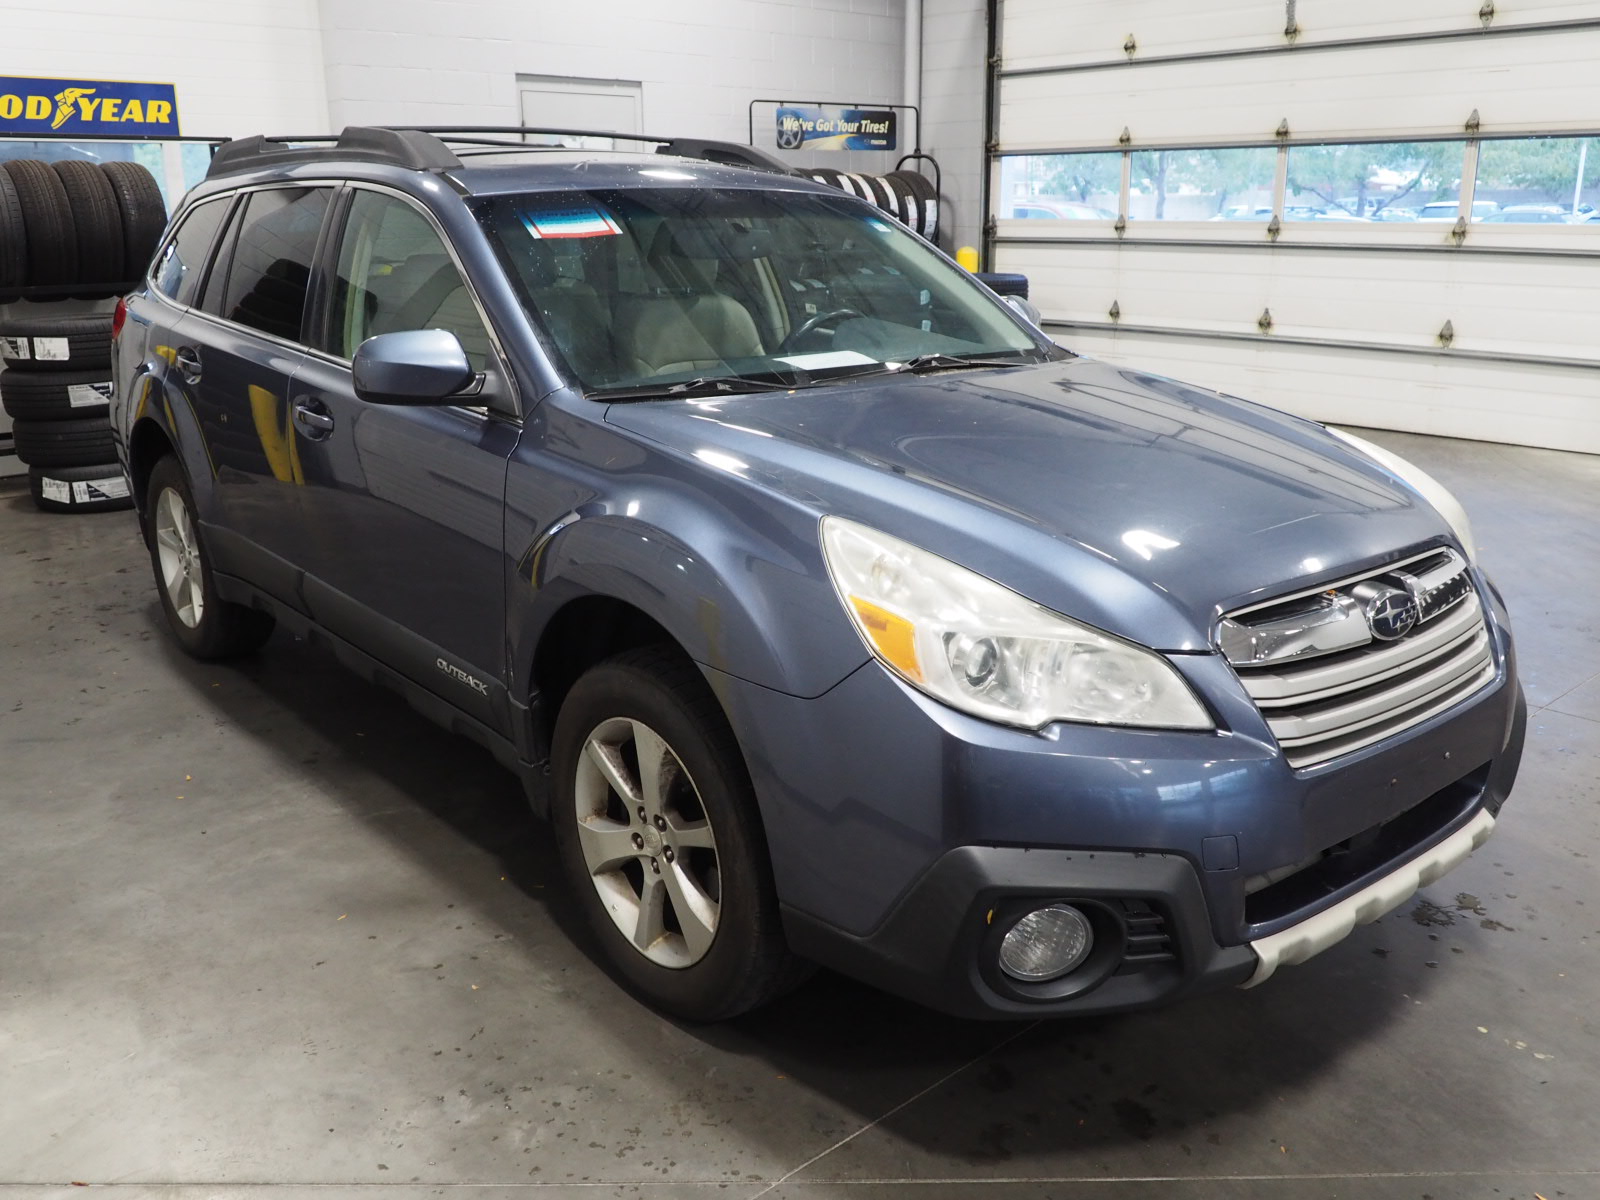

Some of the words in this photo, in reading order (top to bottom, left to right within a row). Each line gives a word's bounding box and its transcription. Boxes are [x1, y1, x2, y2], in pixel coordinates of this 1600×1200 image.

[783, 118, 814, 131] We've
[816, 119, 834, 132] Got
[837, 119, 859, 132] Your
[861, 120, 889, 134] Tires!
[436, 657, 488, 696] OUTBACK
